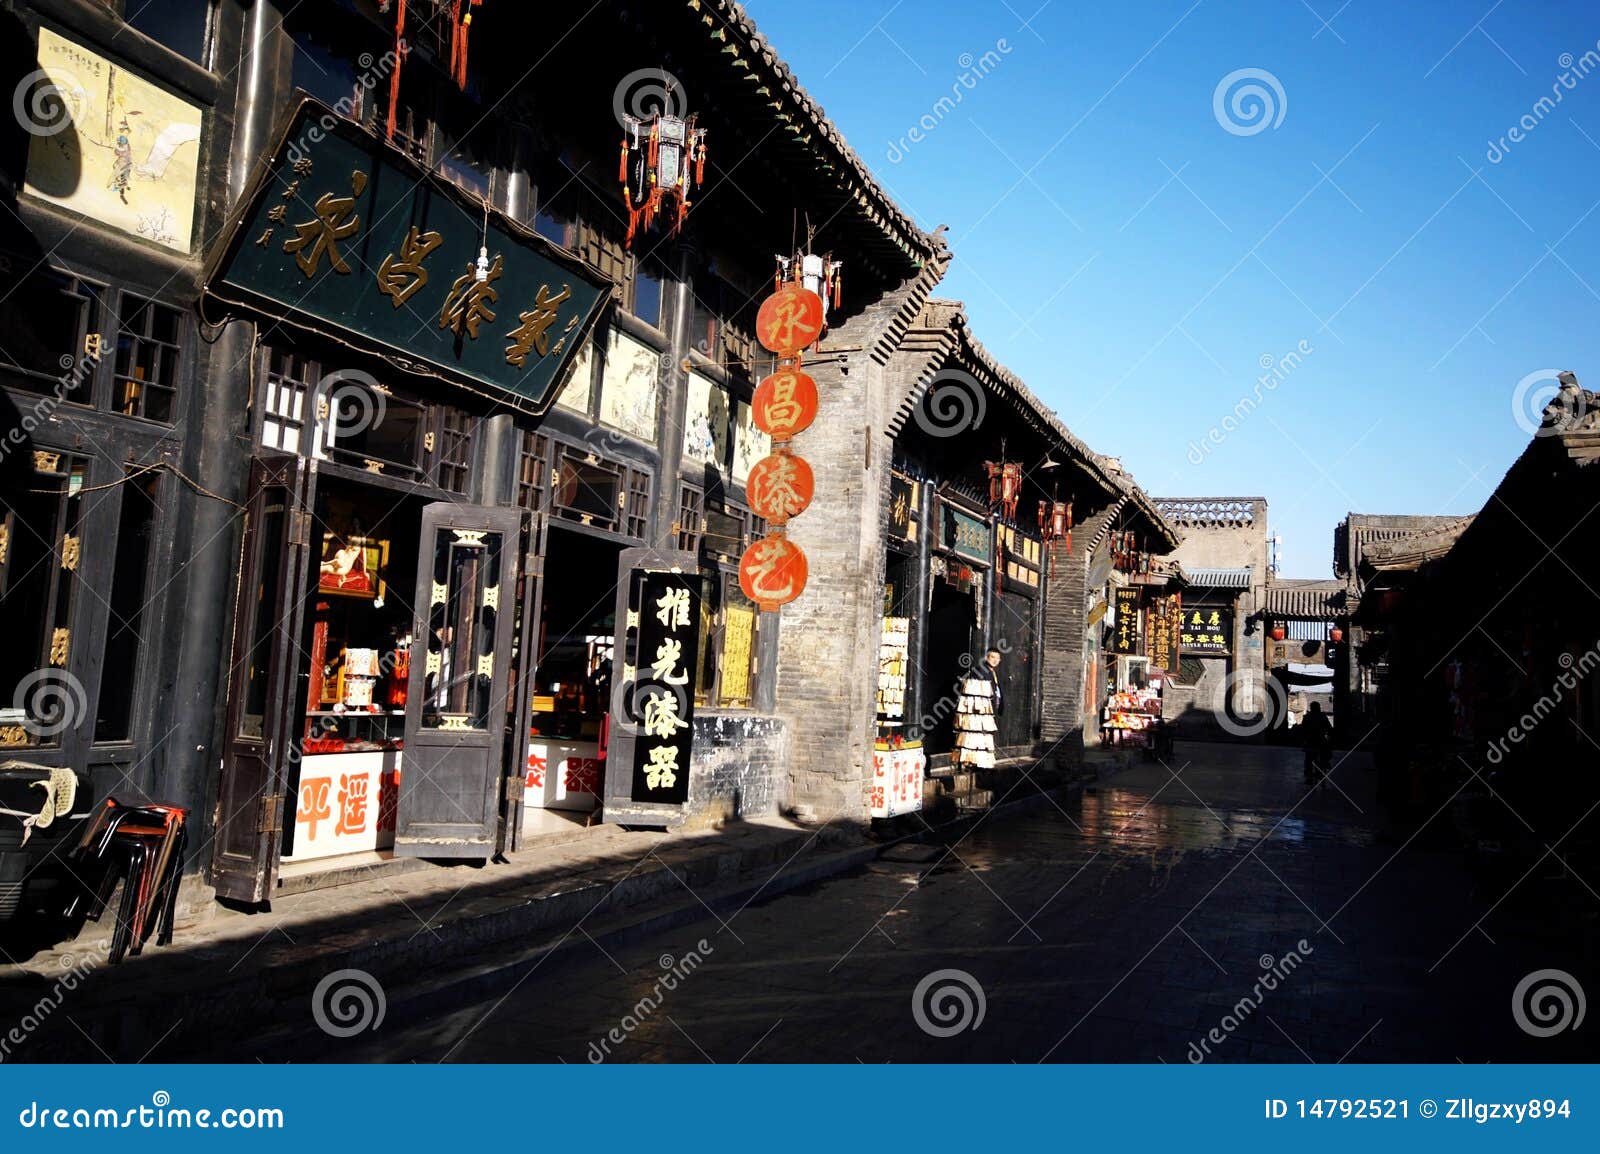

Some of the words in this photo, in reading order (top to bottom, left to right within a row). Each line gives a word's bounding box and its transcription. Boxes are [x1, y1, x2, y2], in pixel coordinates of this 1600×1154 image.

[746, 293, 816, 599] 永昌漆艺
[643, 586, 692, 791] 推光漆器
